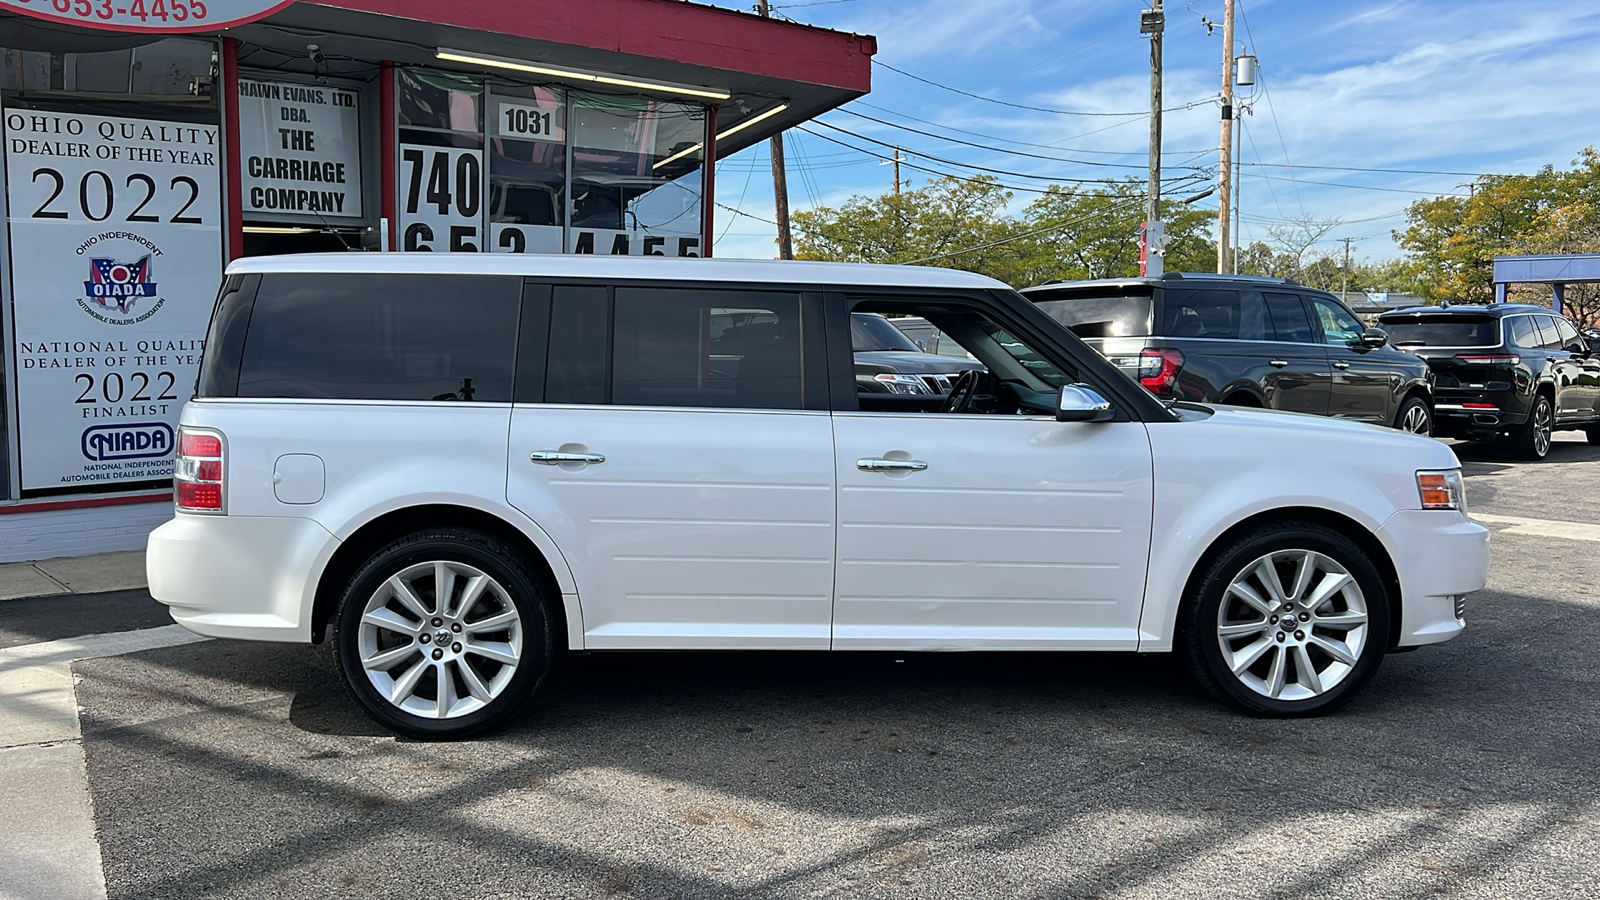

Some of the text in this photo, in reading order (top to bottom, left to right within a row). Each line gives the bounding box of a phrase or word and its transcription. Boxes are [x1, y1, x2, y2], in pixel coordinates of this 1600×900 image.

[238, 81, 356, 108] HAWN EVANS. LTD.
[280, 106, 311, 123] DBA.
[505, 108, 551, 136] 1031
[7, 114, 217, 145] OHIO QUALITY
[278, 128, 315, 152] THE
[11, 138, 215, 166] DEALER OF THE YEAR
[248, 156, 346, 184] CARRIAGE
[31, 167, 203, 225] 2022
[403, 149, 480, 218] 740
[250, 186, 346, 213] COMPANY
[76, 231, 163, 257] OHIO INDEPENDENT
[93, 283, 146, 296] OIADA
[76, 297, 166, 326] AUTOMOBILE DEALERS ASSOCIATION
[20, 340, 205, 354] NATIONAL QUALIT
[24, 357, 96, 369] DEALER
[105, 356, 126, 367] OF
[134, 355, 167, 366] THE
[74, 371, 177, 404] 2022
[82, 404, 169, 418] FINALIST
[89, 429, 166, 453] NIADA
[60, 468, 174, 483] AUTOMOBILE DEALERS ASSOCI
[84, 459, 174, 472] NATIONAL INDEPENDENT
